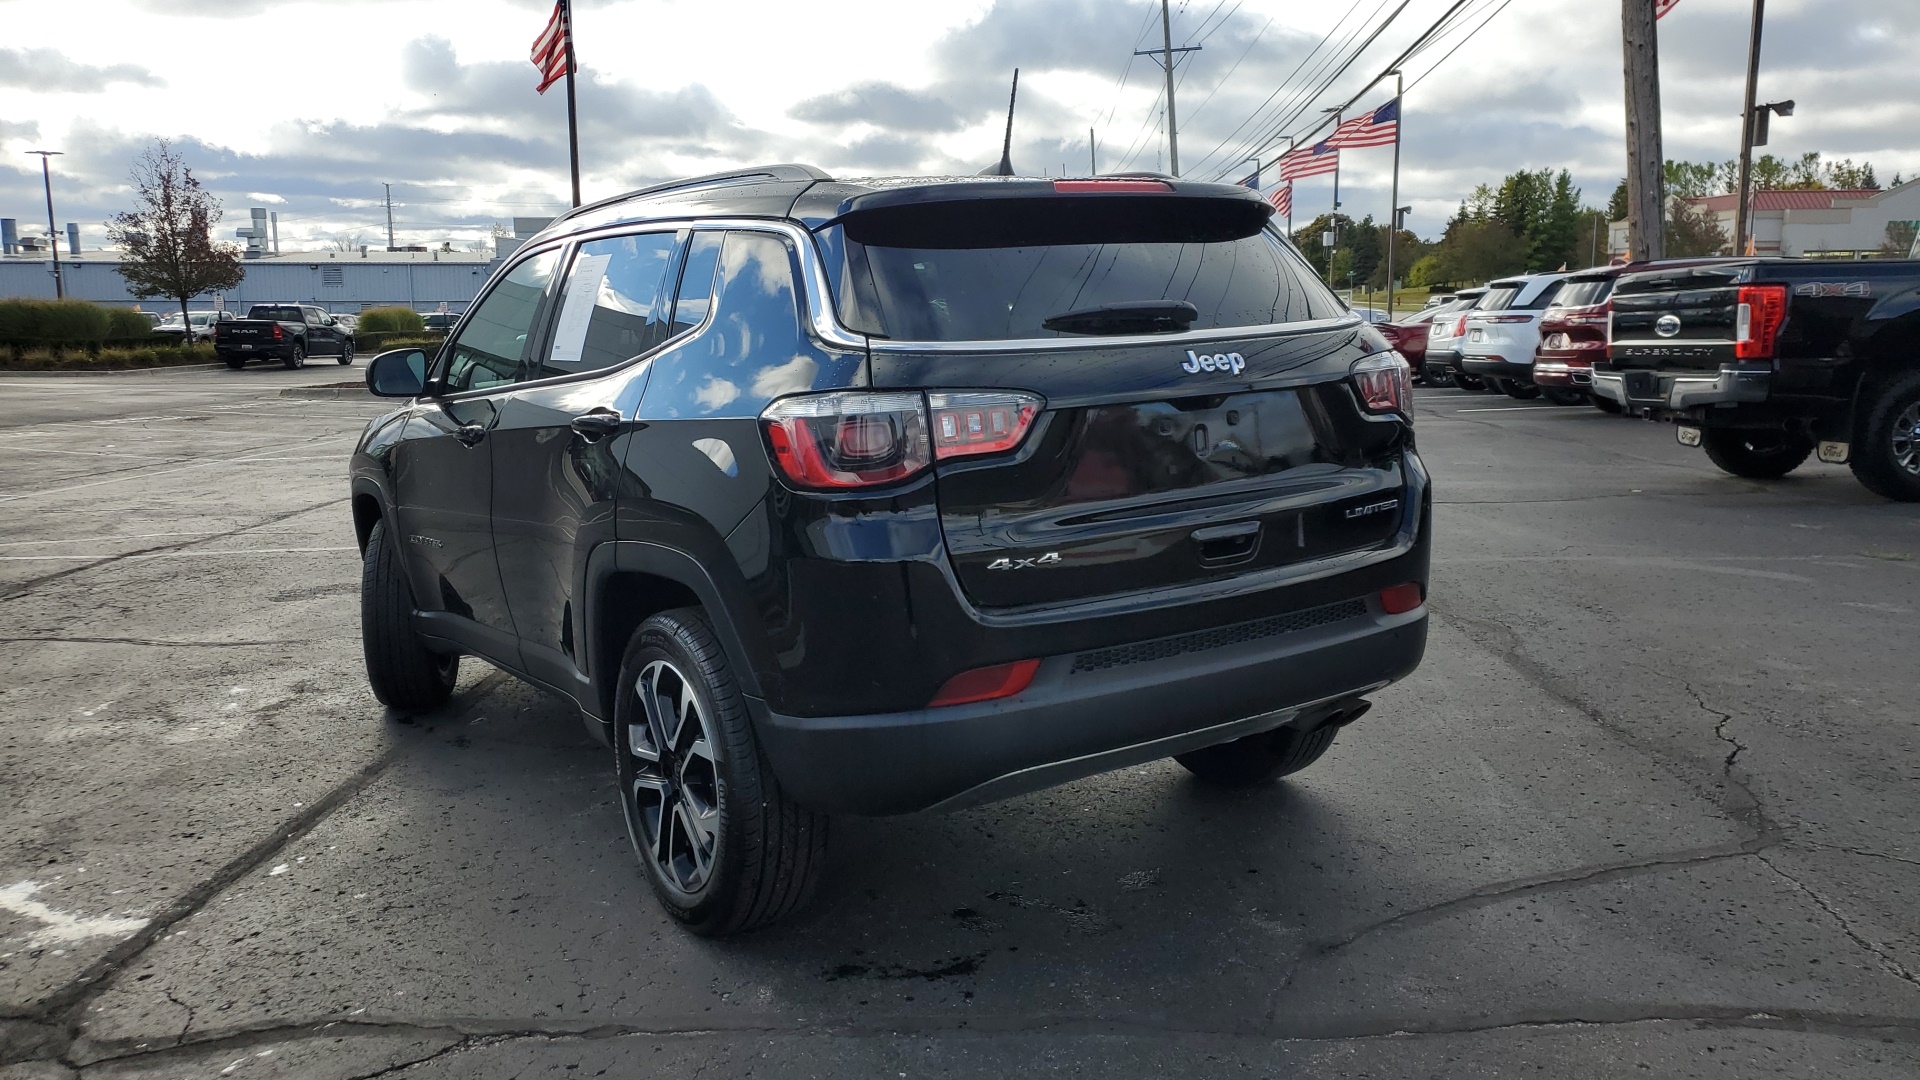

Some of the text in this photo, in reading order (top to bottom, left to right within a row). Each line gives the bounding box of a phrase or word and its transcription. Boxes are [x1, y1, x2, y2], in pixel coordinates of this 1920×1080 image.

[1625, 348, 1670, 356] SUPER
[1181, 350, 1246, 376] Jeep
[1823, 445, 1844, 458] Ford
[1346, 499, 1399, 519] LIMITED
